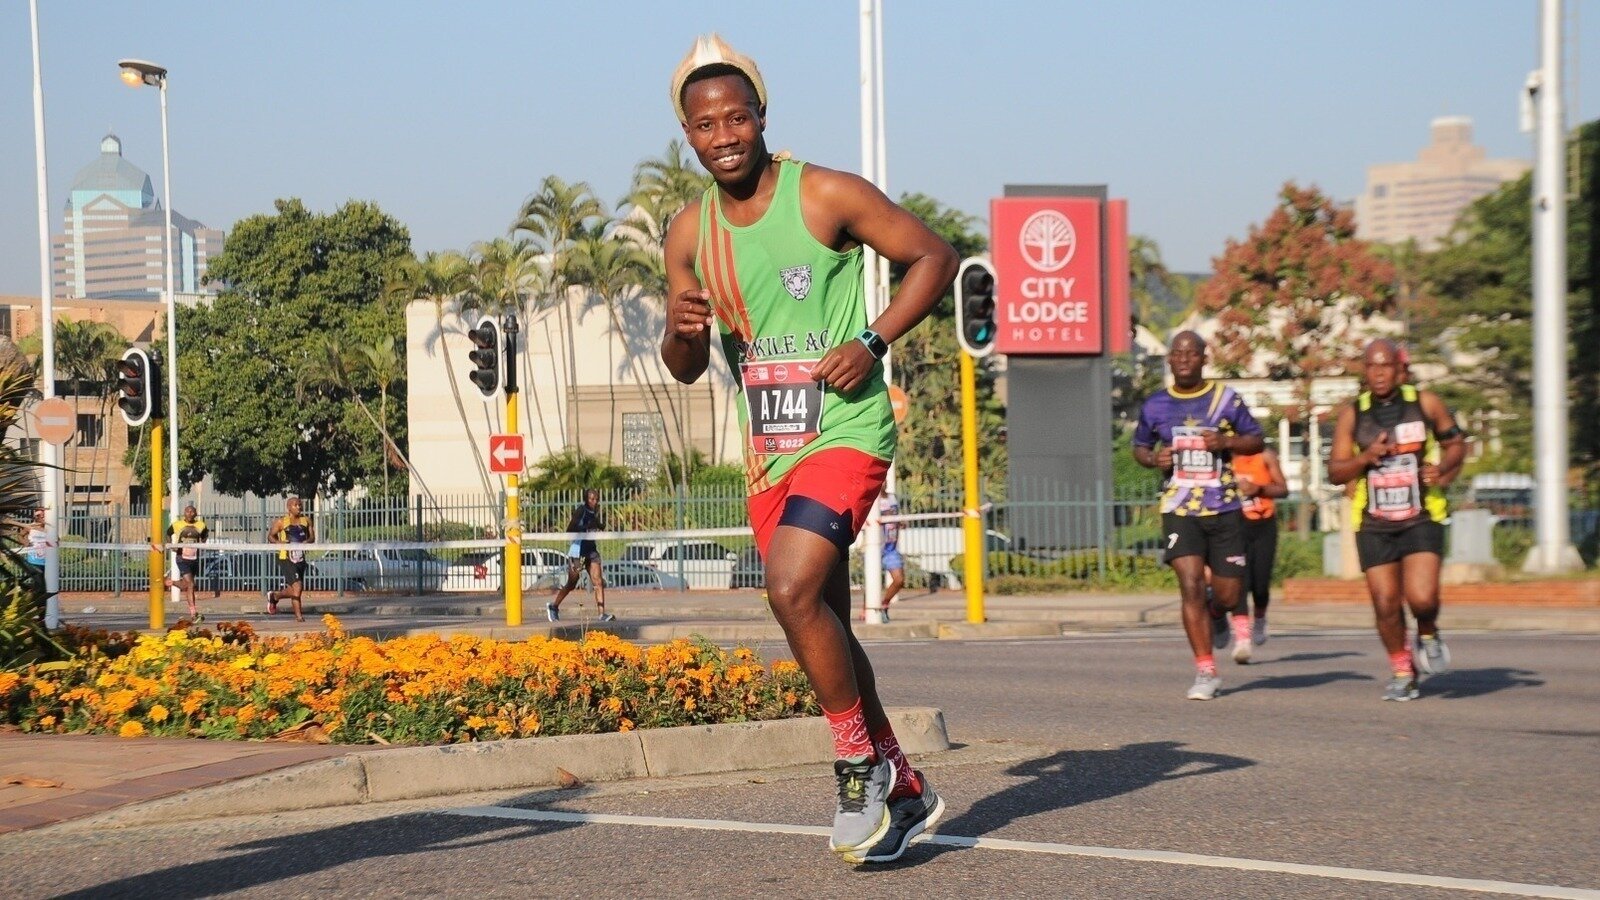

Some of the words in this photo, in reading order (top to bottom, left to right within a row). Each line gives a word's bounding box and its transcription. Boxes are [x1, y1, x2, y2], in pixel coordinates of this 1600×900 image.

[1020, 277, 1076, 298] CITY
[1008, 302, 1089, 323] LODGE
[738, 334, 797, 360] KILE
[805, 329, 832, 352] AC
[1012, 327, 1085, 341] HOTEL
[761, 389, 808, 420] A744
[779, 438, 805, 449] 2022
